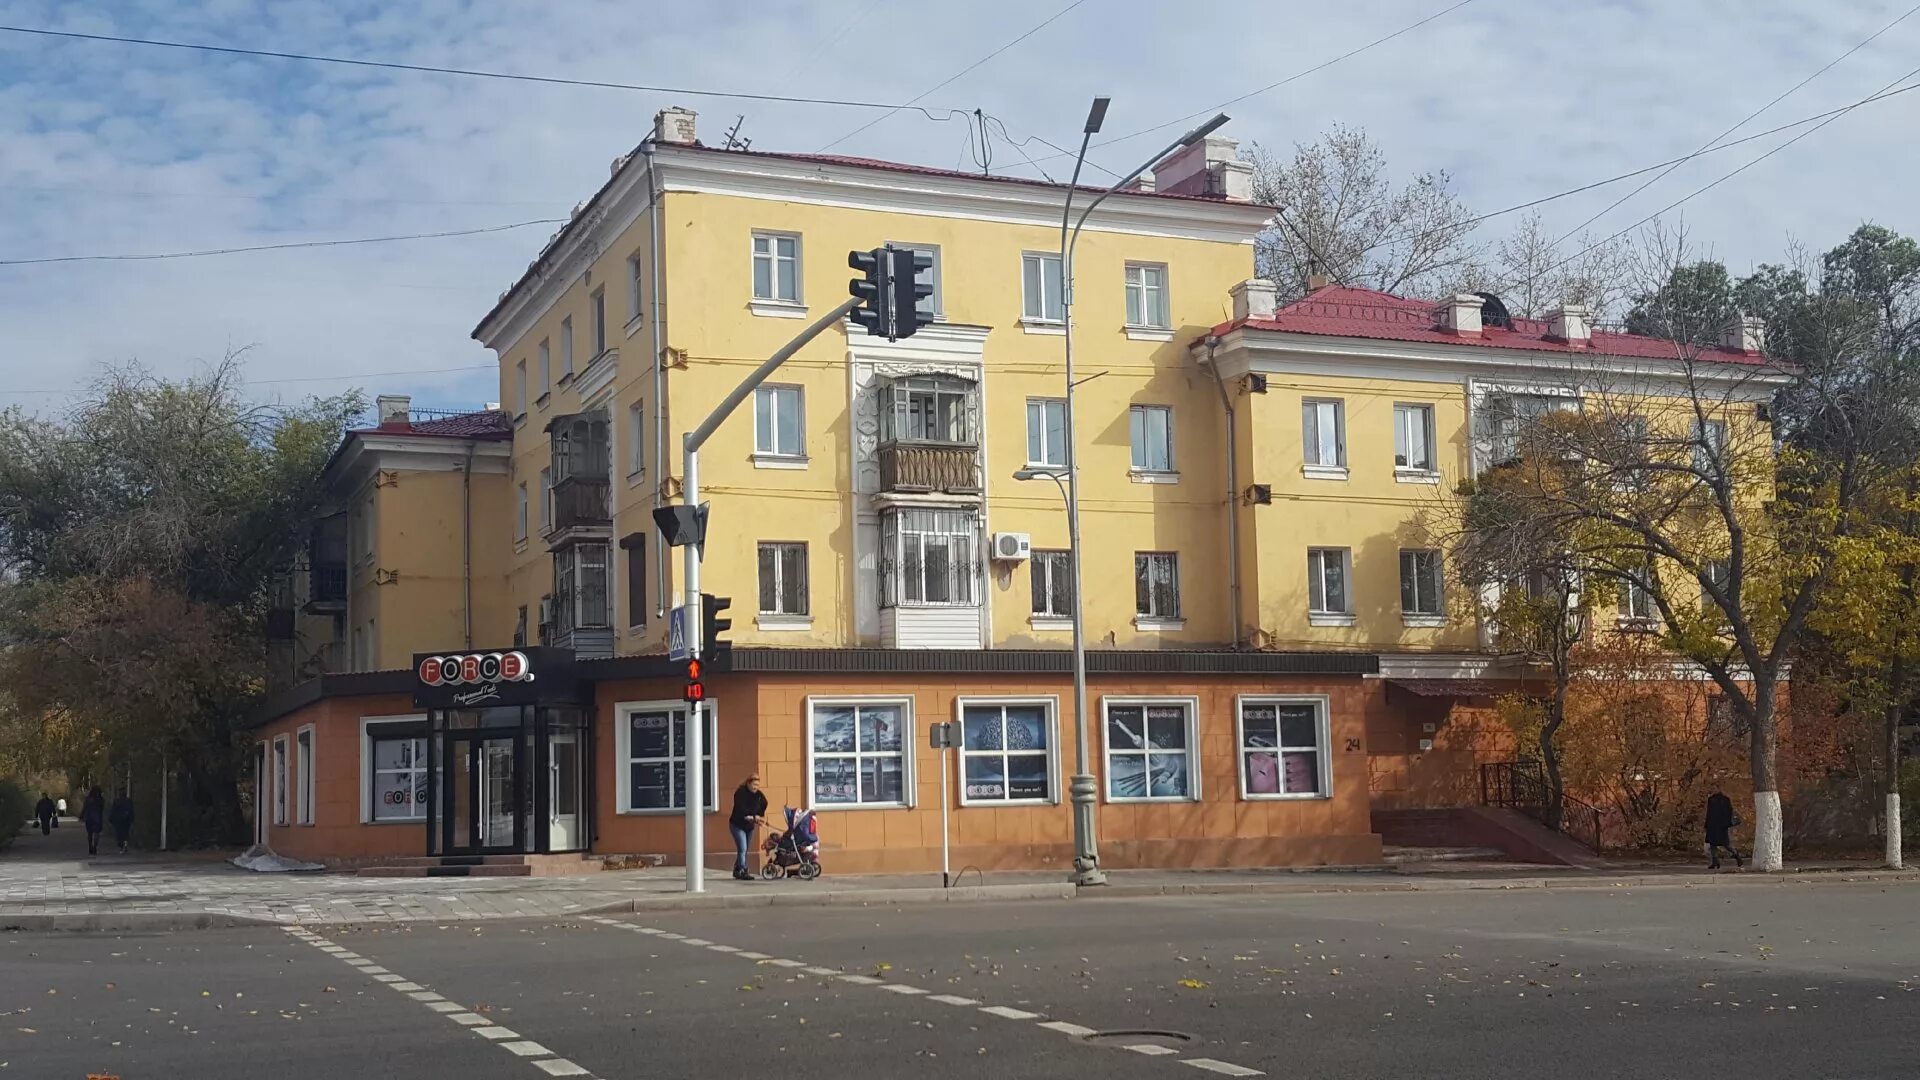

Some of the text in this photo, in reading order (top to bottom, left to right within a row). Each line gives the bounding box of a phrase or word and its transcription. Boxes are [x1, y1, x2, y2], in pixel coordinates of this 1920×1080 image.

[422, 656, 518, 682] FORCE
[687, 684, 702, 699] 10
[1345, 738, 1360, 751] 24
